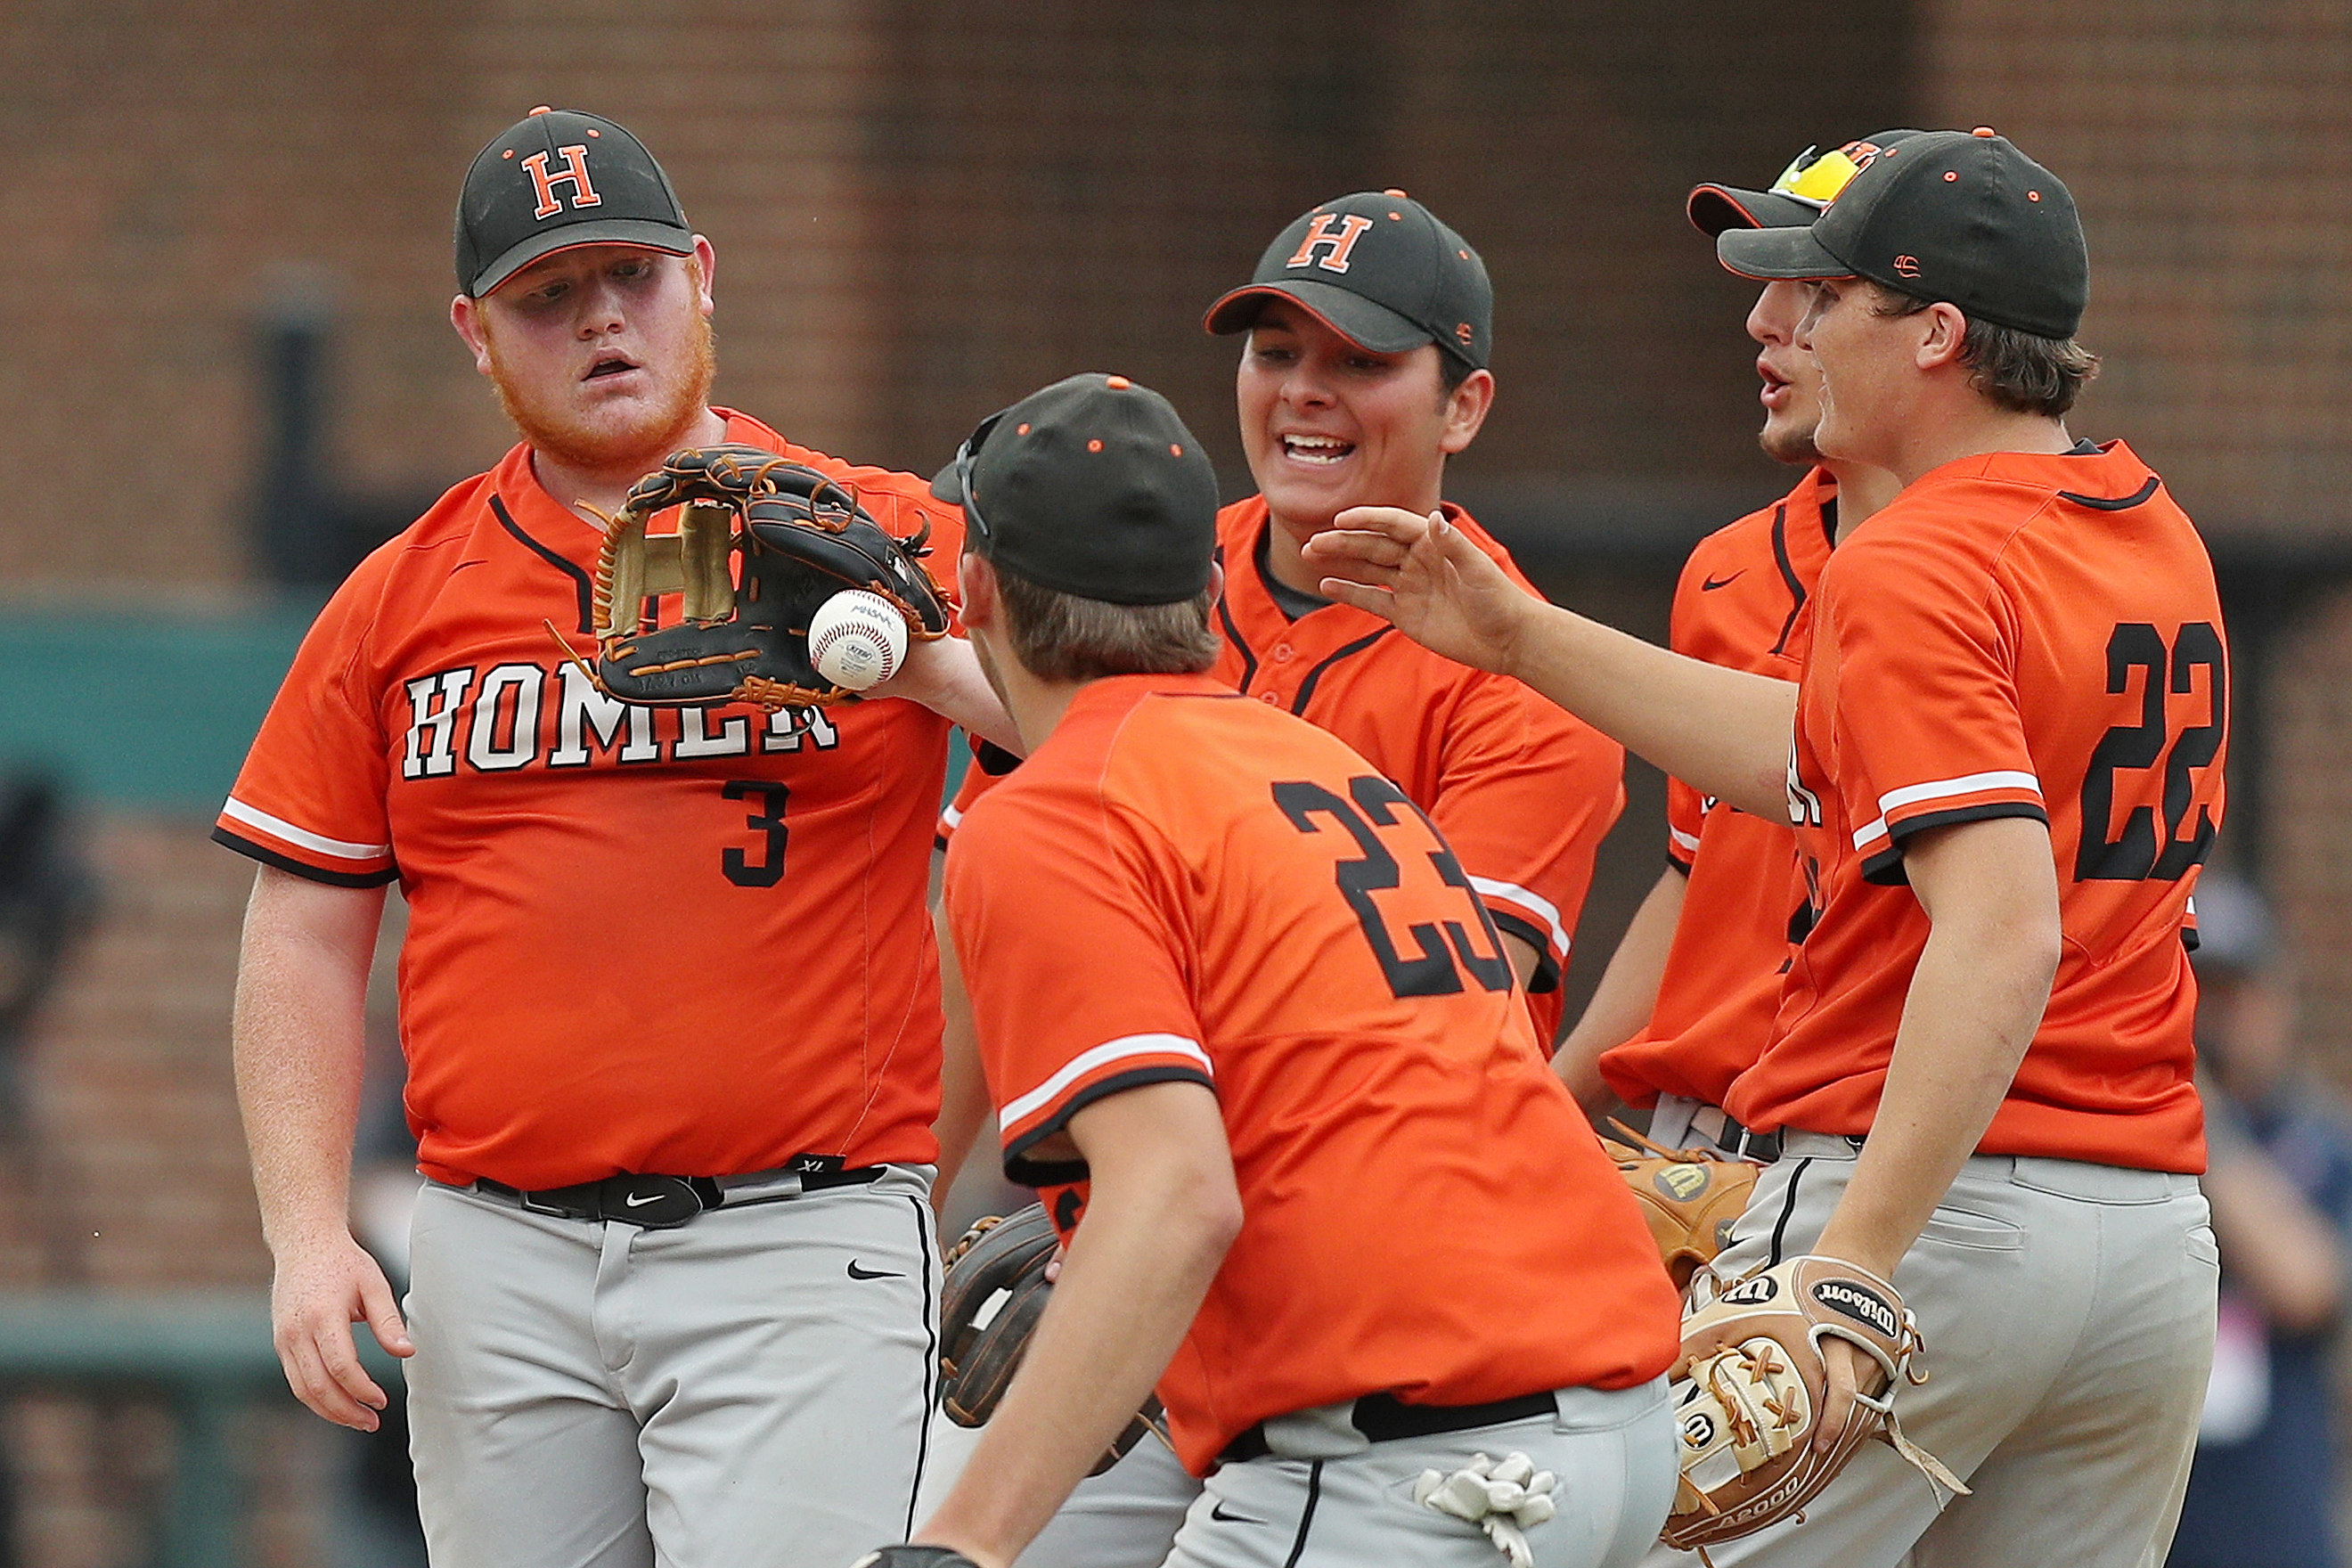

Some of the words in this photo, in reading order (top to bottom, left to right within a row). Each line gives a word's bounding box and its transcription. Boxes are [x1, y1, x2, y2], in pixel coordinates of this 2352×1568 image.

[519, 143, 603, 222] H
[1286, 213, 1375, 274] H
[2073, 622, 2225, 883] 22
[721, 780, 791, 887] 3
[1271, 775, 1514, 999] 23
[1818, 1284, 1897, 1336] Wilson
[1719, 1476, 1798, 1529] A2000
